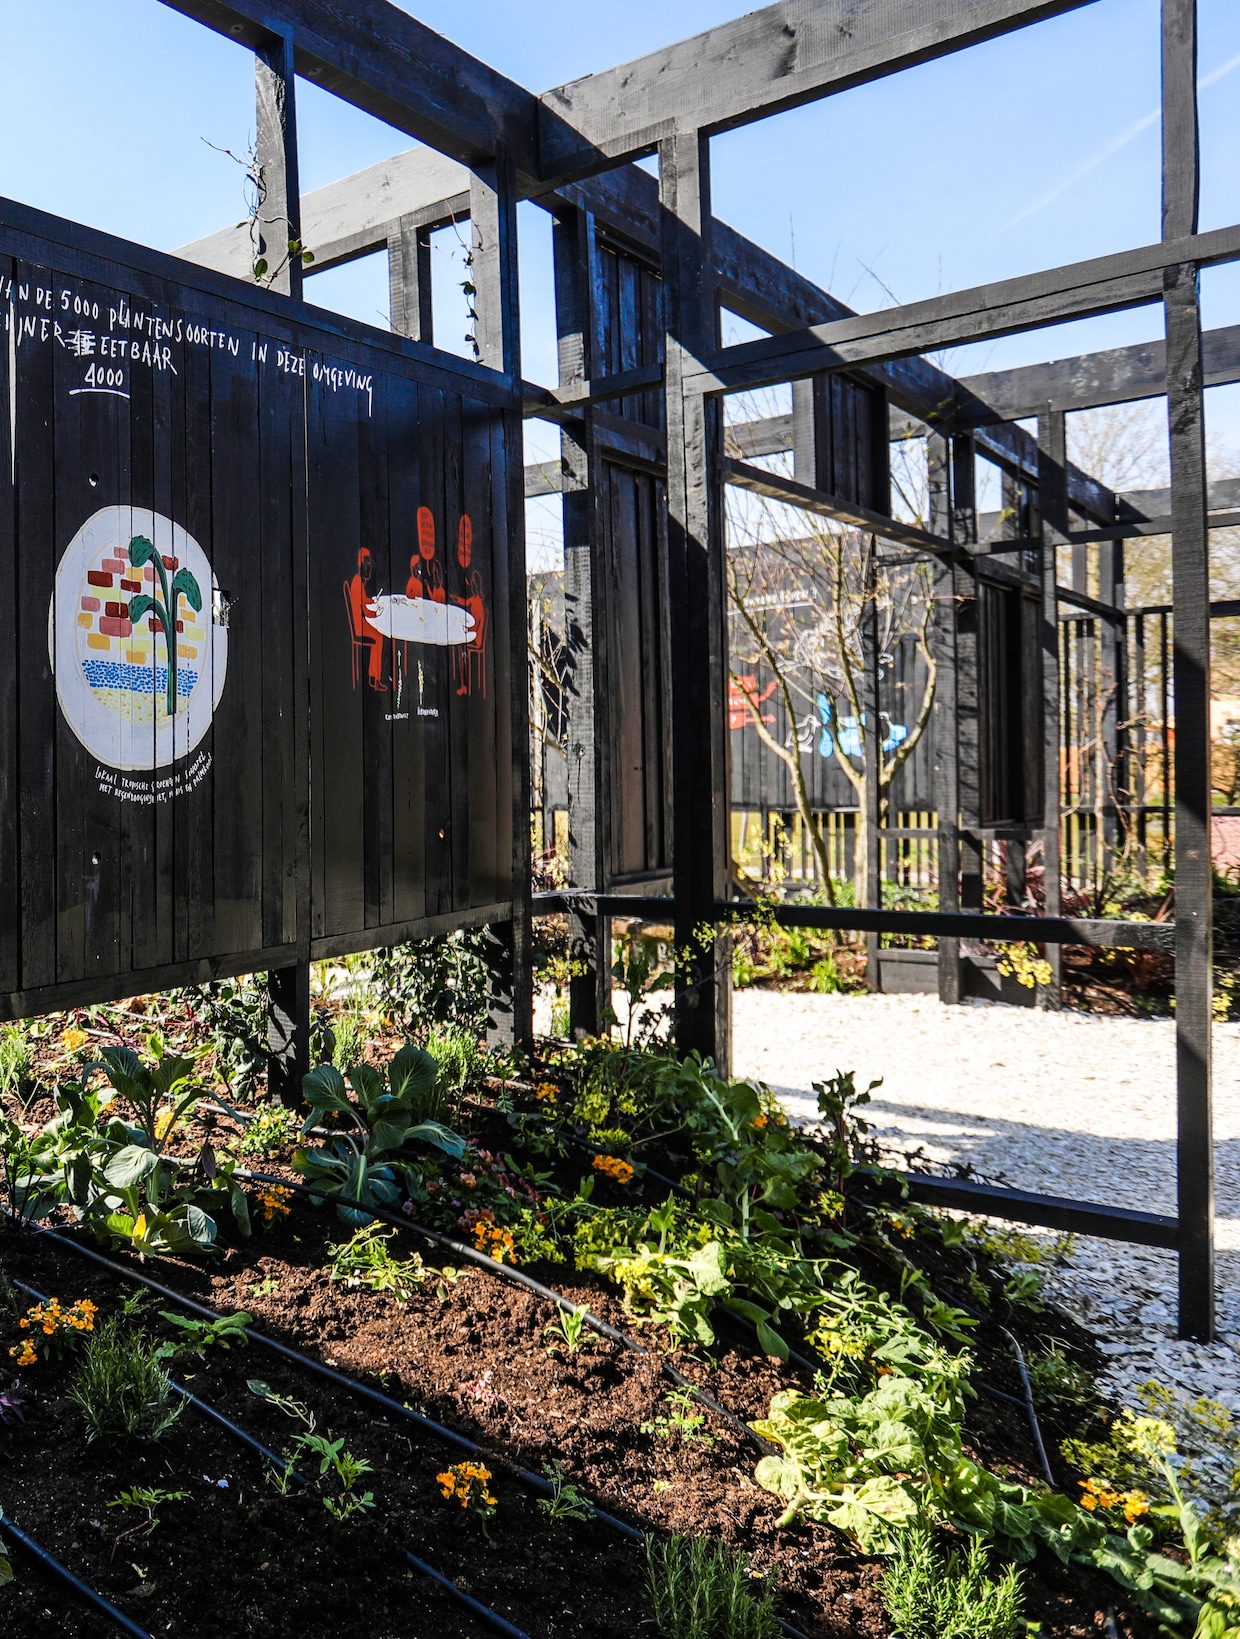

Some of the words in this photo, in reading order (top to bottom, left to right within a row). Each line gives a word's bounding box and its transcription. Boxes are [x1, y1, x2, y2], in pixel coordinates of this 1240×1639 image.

[36, 287, 52, 310] DE
[60, 290, 99, 320] 5000
[110, 299, 239, 356] PLANTENSOORTEN
[252, 341, 268, 363] IN
[276, 349, 305, 376] DEZE
[312, 362, 373, 417] OMGEVING
[100, 336, 178, 376] EETBAAR
[84, 362, 124, 388] 4000
[95, 765, 117, 785] LOKAAL
[99, 783, 113, 795] MET
